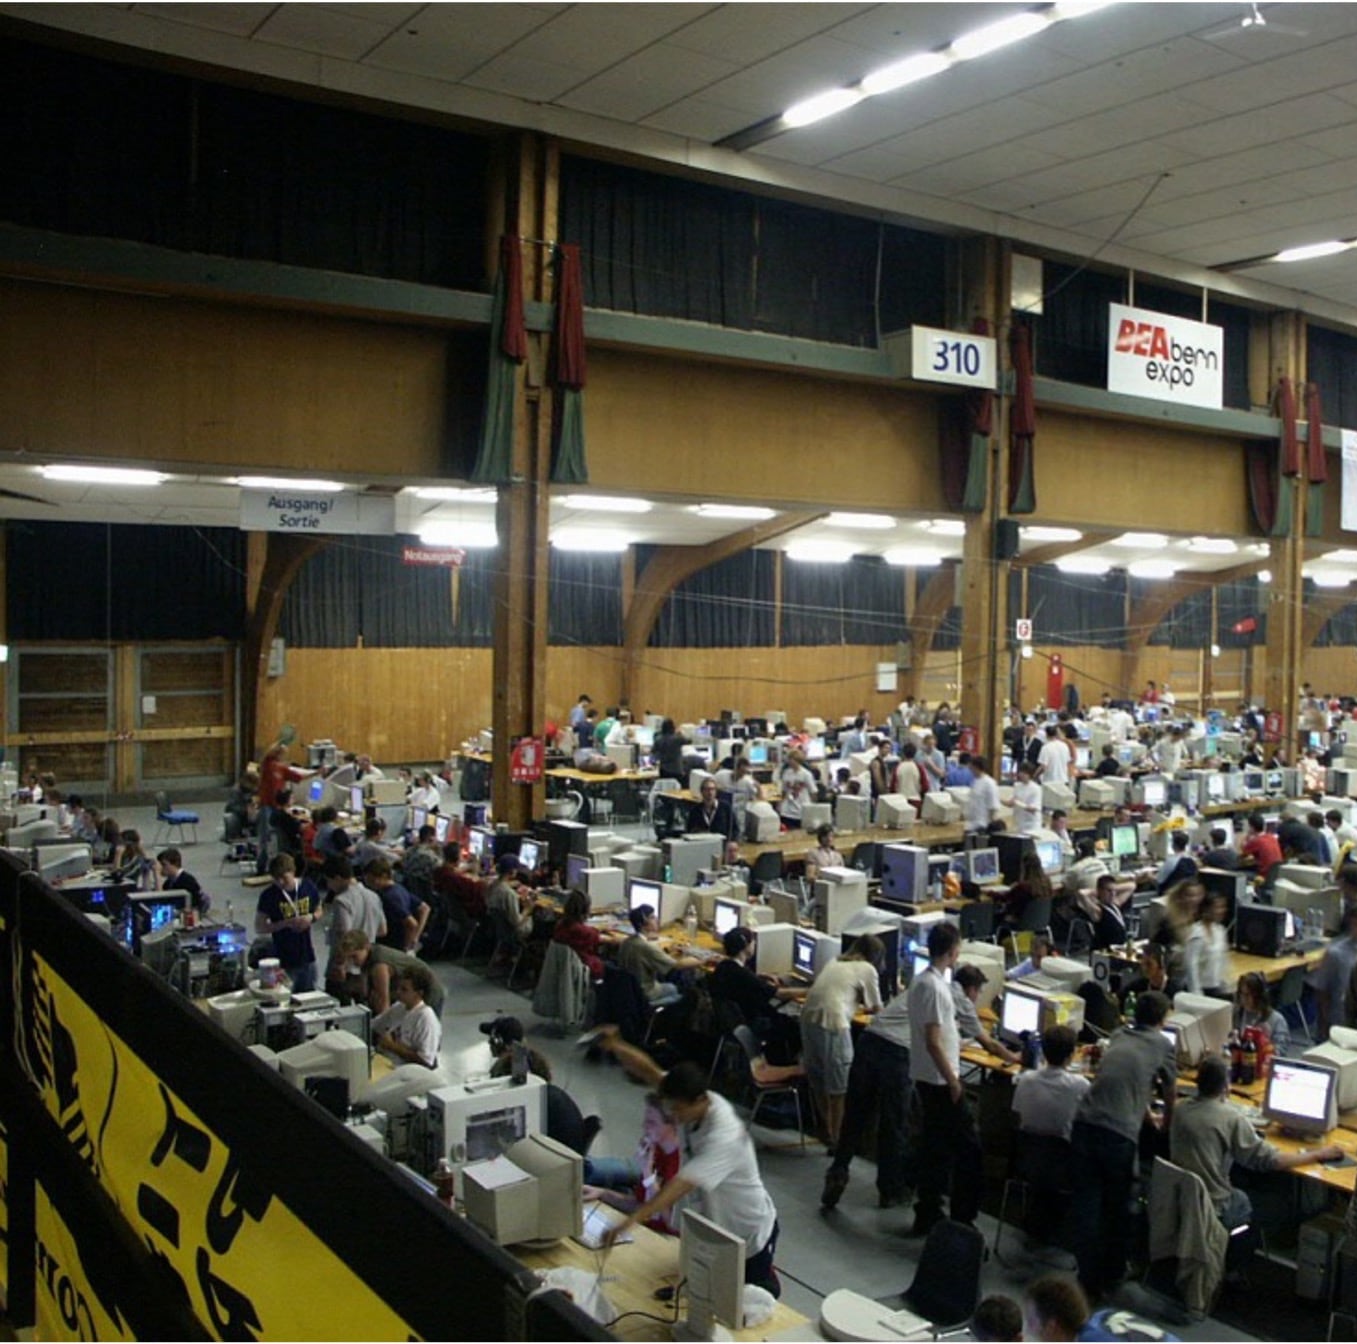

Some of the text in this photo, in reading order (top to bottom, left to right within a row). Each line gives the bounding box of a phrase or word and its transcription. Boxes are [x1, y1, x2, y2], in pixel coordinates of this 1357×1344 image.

[932, 340, 980, 376] 310
[1145, 360, 1195, 389] expo
[278, 513, 320, 529] Sortie
